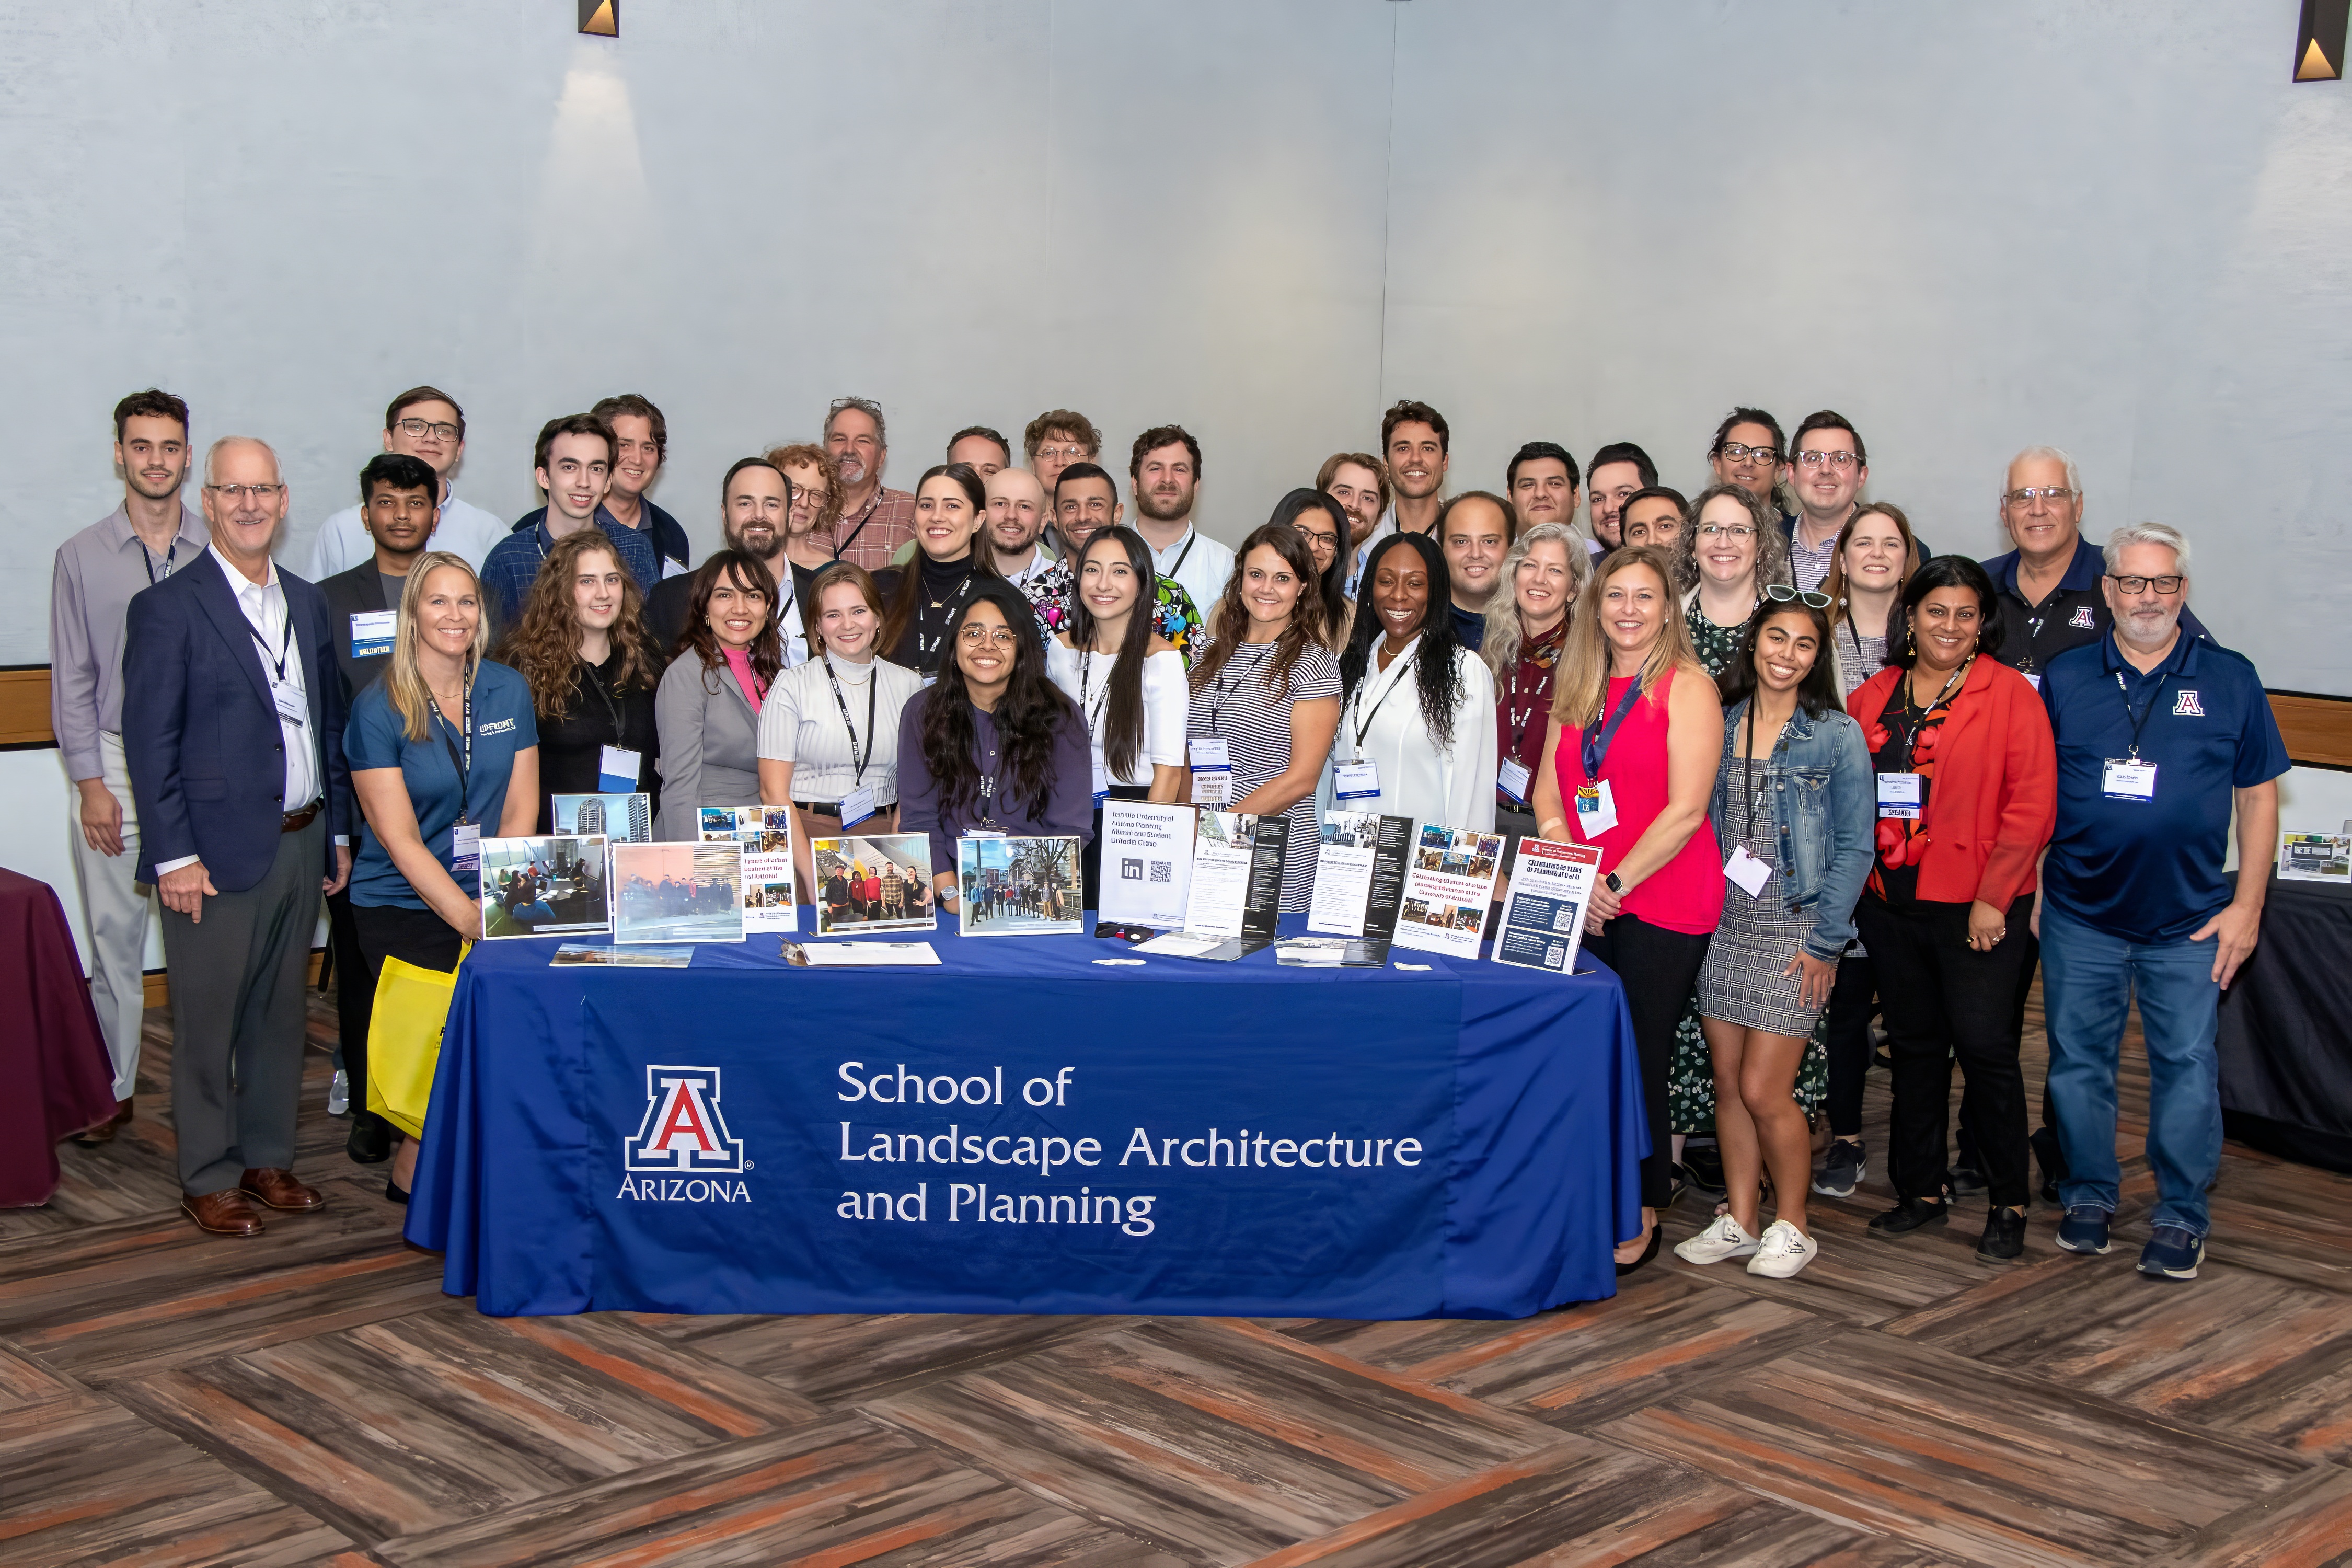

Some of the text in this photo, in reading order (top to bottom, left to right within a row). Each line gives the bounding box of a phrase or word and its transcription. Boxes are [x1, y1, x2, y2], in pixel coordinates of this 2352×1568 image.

[2069, 606, 2094, 629] A
[2173, 690, 2205, 717] A
[1124, 860, 1140, 878] in
[838, 1062, 1075, 1106] School of
[625, 1065, 743, 1173] A
[839, 1121, 1422, 1177] Landscape Architecture
[616, 1172, 752, 1203] ARIZONA
[837, 1182, 1157, 1237] and Planning
